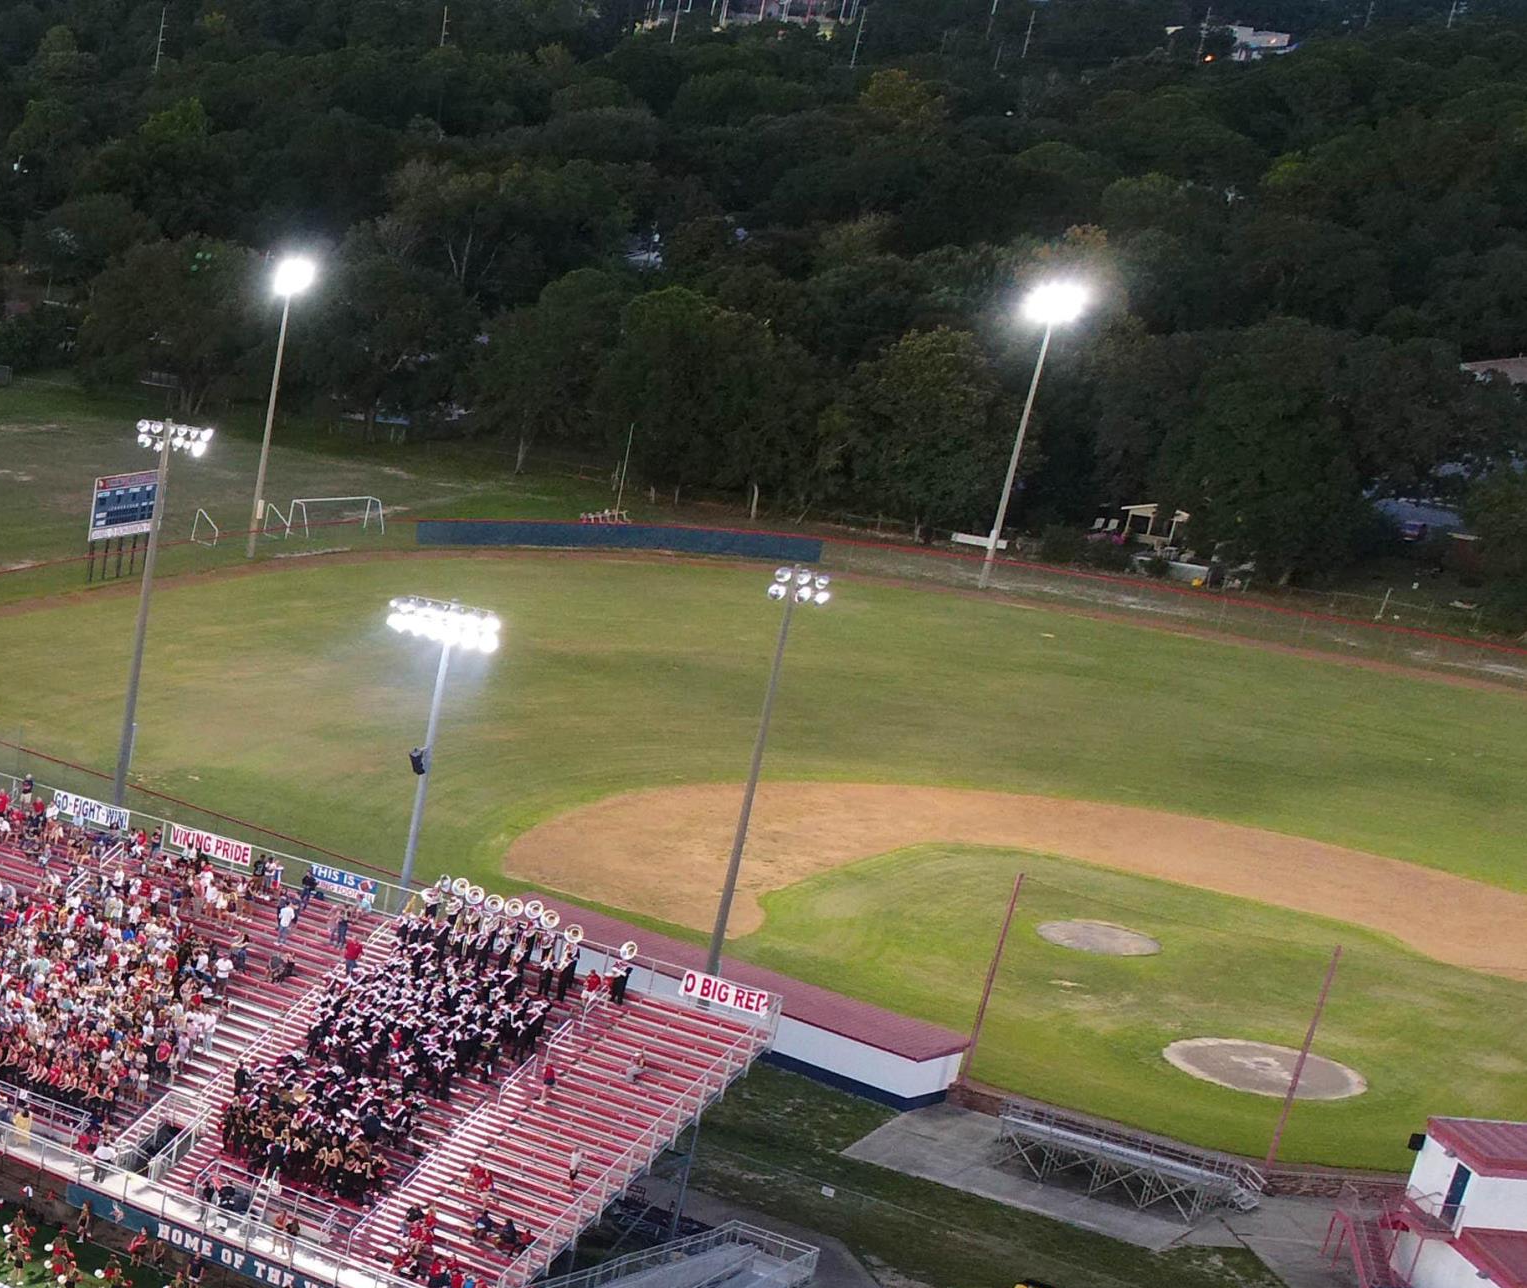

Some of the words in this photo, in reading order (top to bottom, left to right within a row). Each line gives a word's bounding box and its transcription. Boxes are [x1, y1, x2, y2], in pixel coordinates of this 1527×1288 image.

[171, 826, 212, 853] VIKING
[214, 838, 249, 864] PRIDE
[311, 864, 340, 882] THIS
[343, 873, 356, 886] IS
[700, 977, 730, 1003] BIG
[157, 1222, 213, 1257] HOME
[221, 1249, 245, 1270] OF
[254, 1260, 294, 1288] THE
